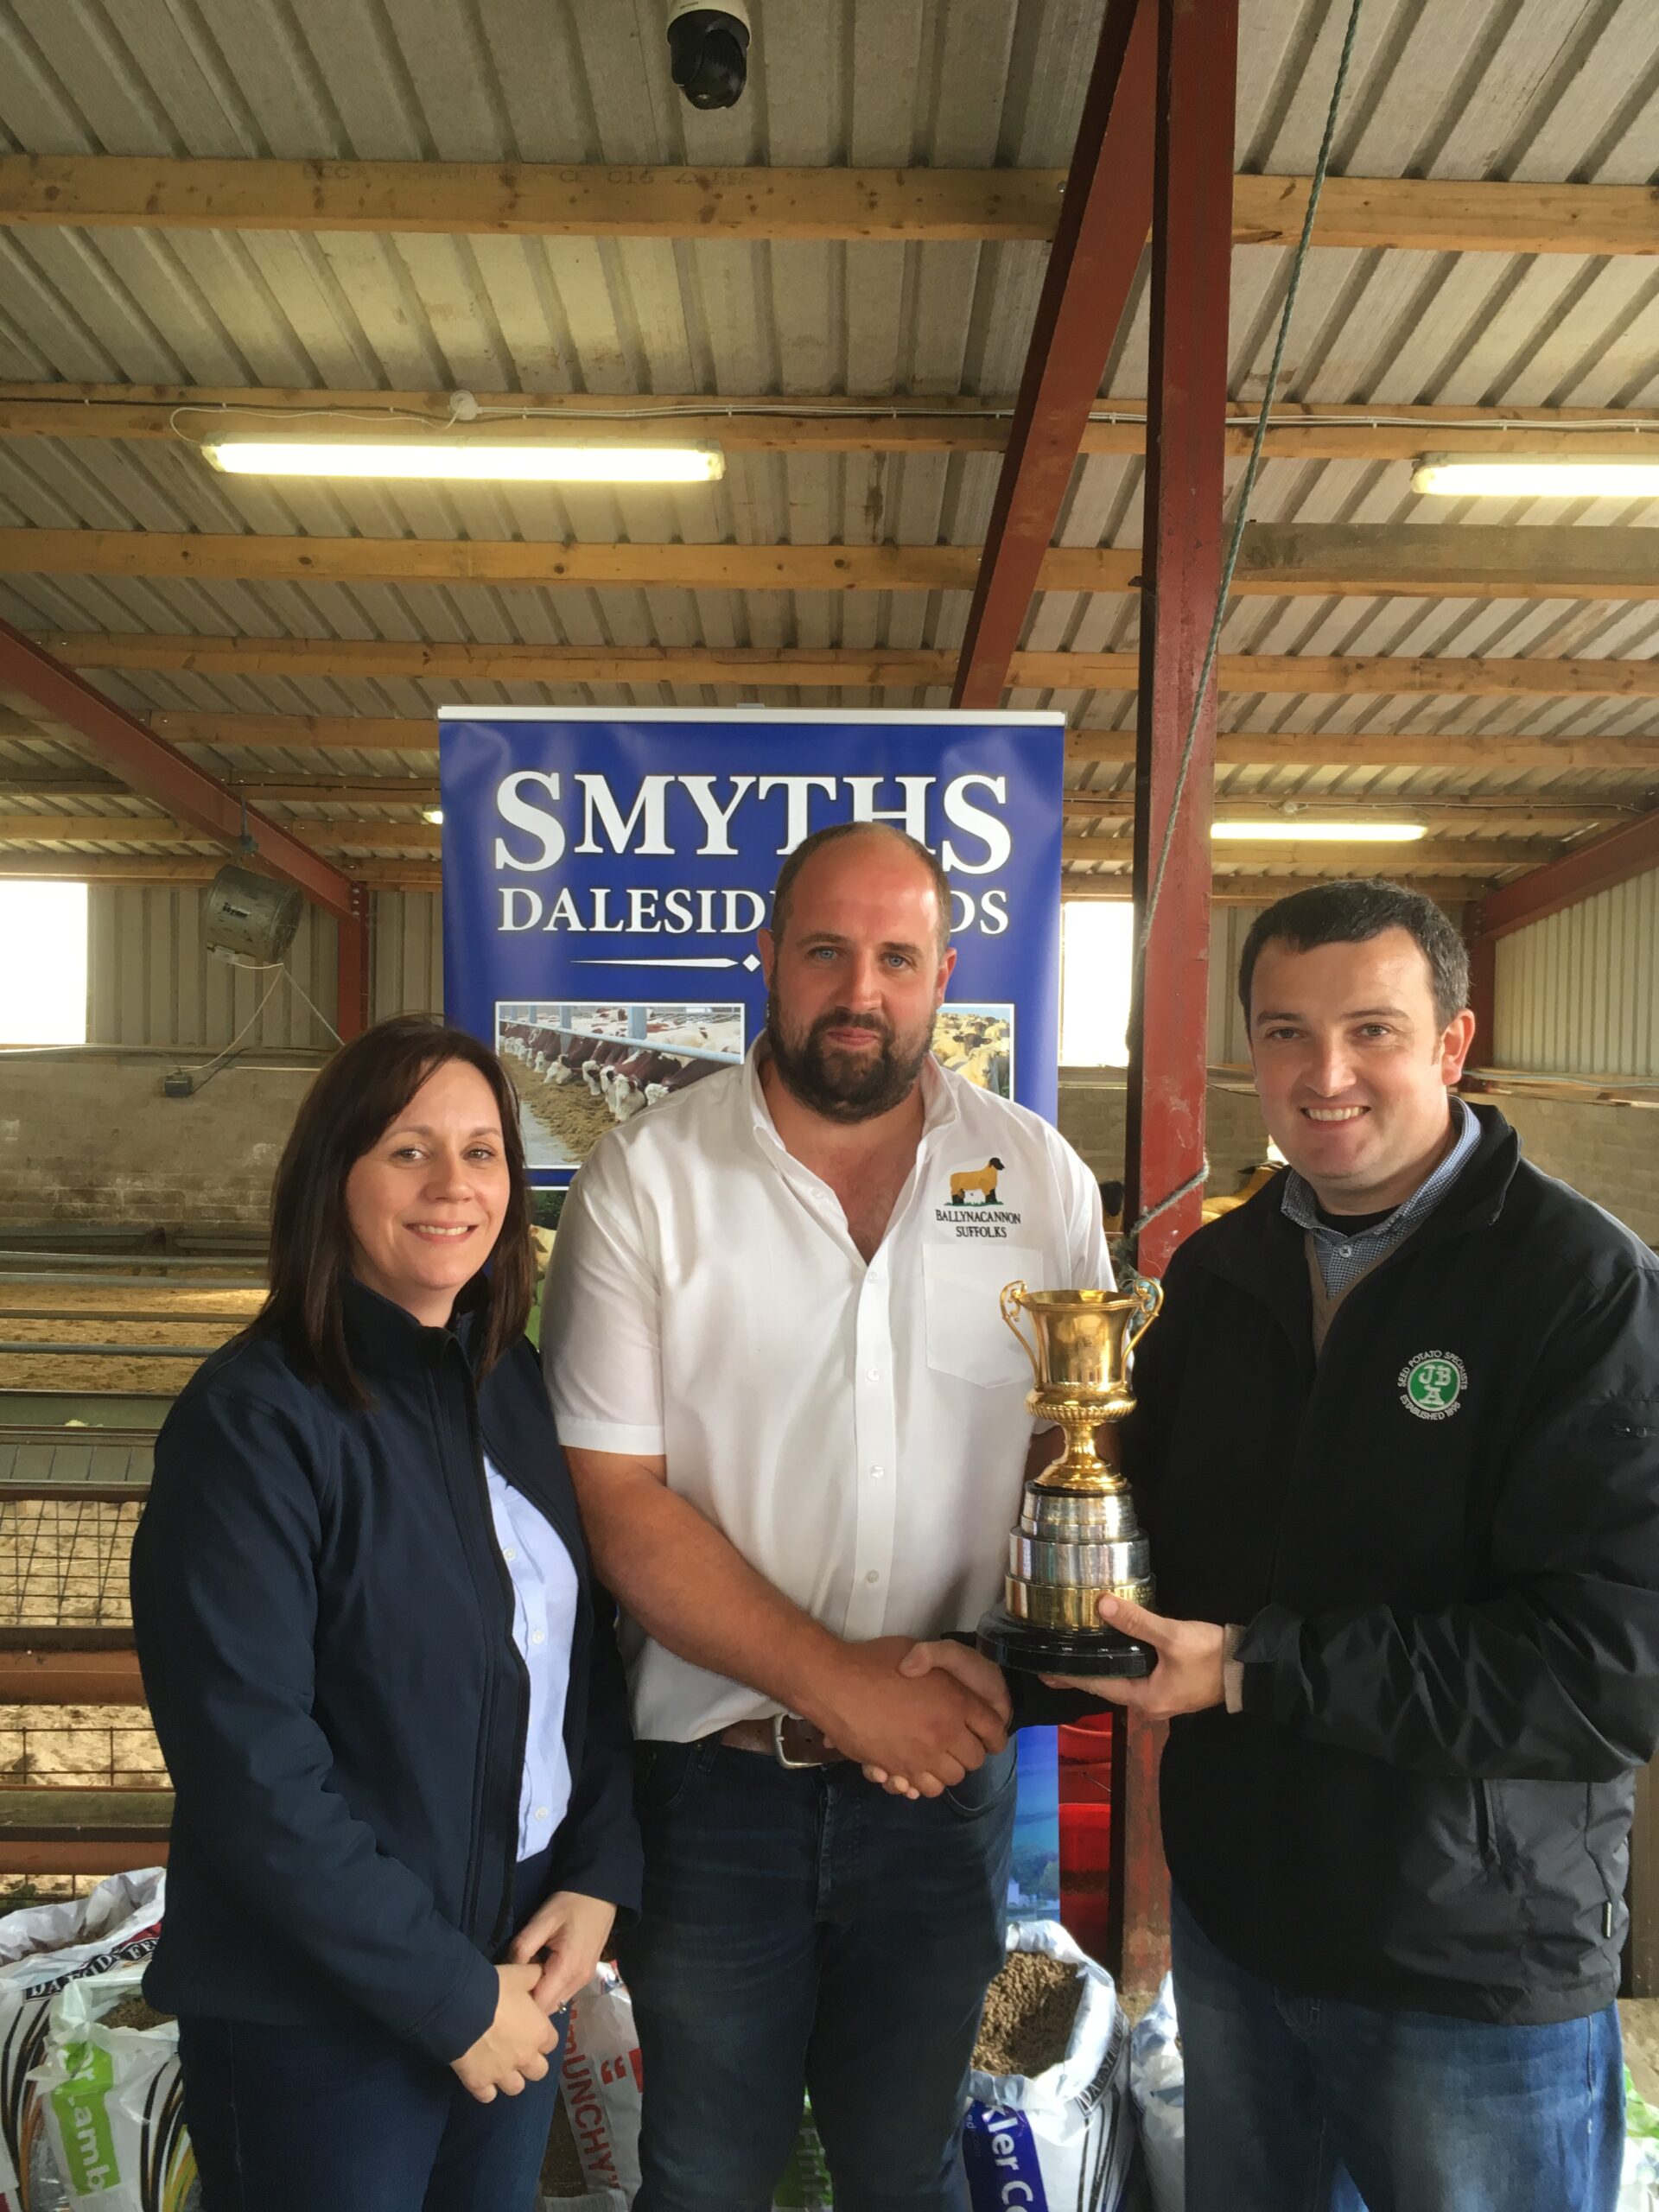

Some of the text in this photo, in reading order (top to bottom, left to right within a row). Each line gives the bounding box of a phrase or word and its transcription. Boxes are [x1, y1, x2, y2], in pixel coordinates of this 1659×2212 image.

[495, 771, 1012, 874] SMYTHS
[498, 887, 775, 934] DALESID
[935, 1209, 1021, 1224] BALLYNACANNON
[956, 1225, 1007, 1238] SUFFOLKS
[1397, 1350, 1468, 1390] SEED POTATO SPECIALISTS
[1399, 1394, 1446, 1420] ESTABLISHED
[1001, 2180, 1033, 2212] C
